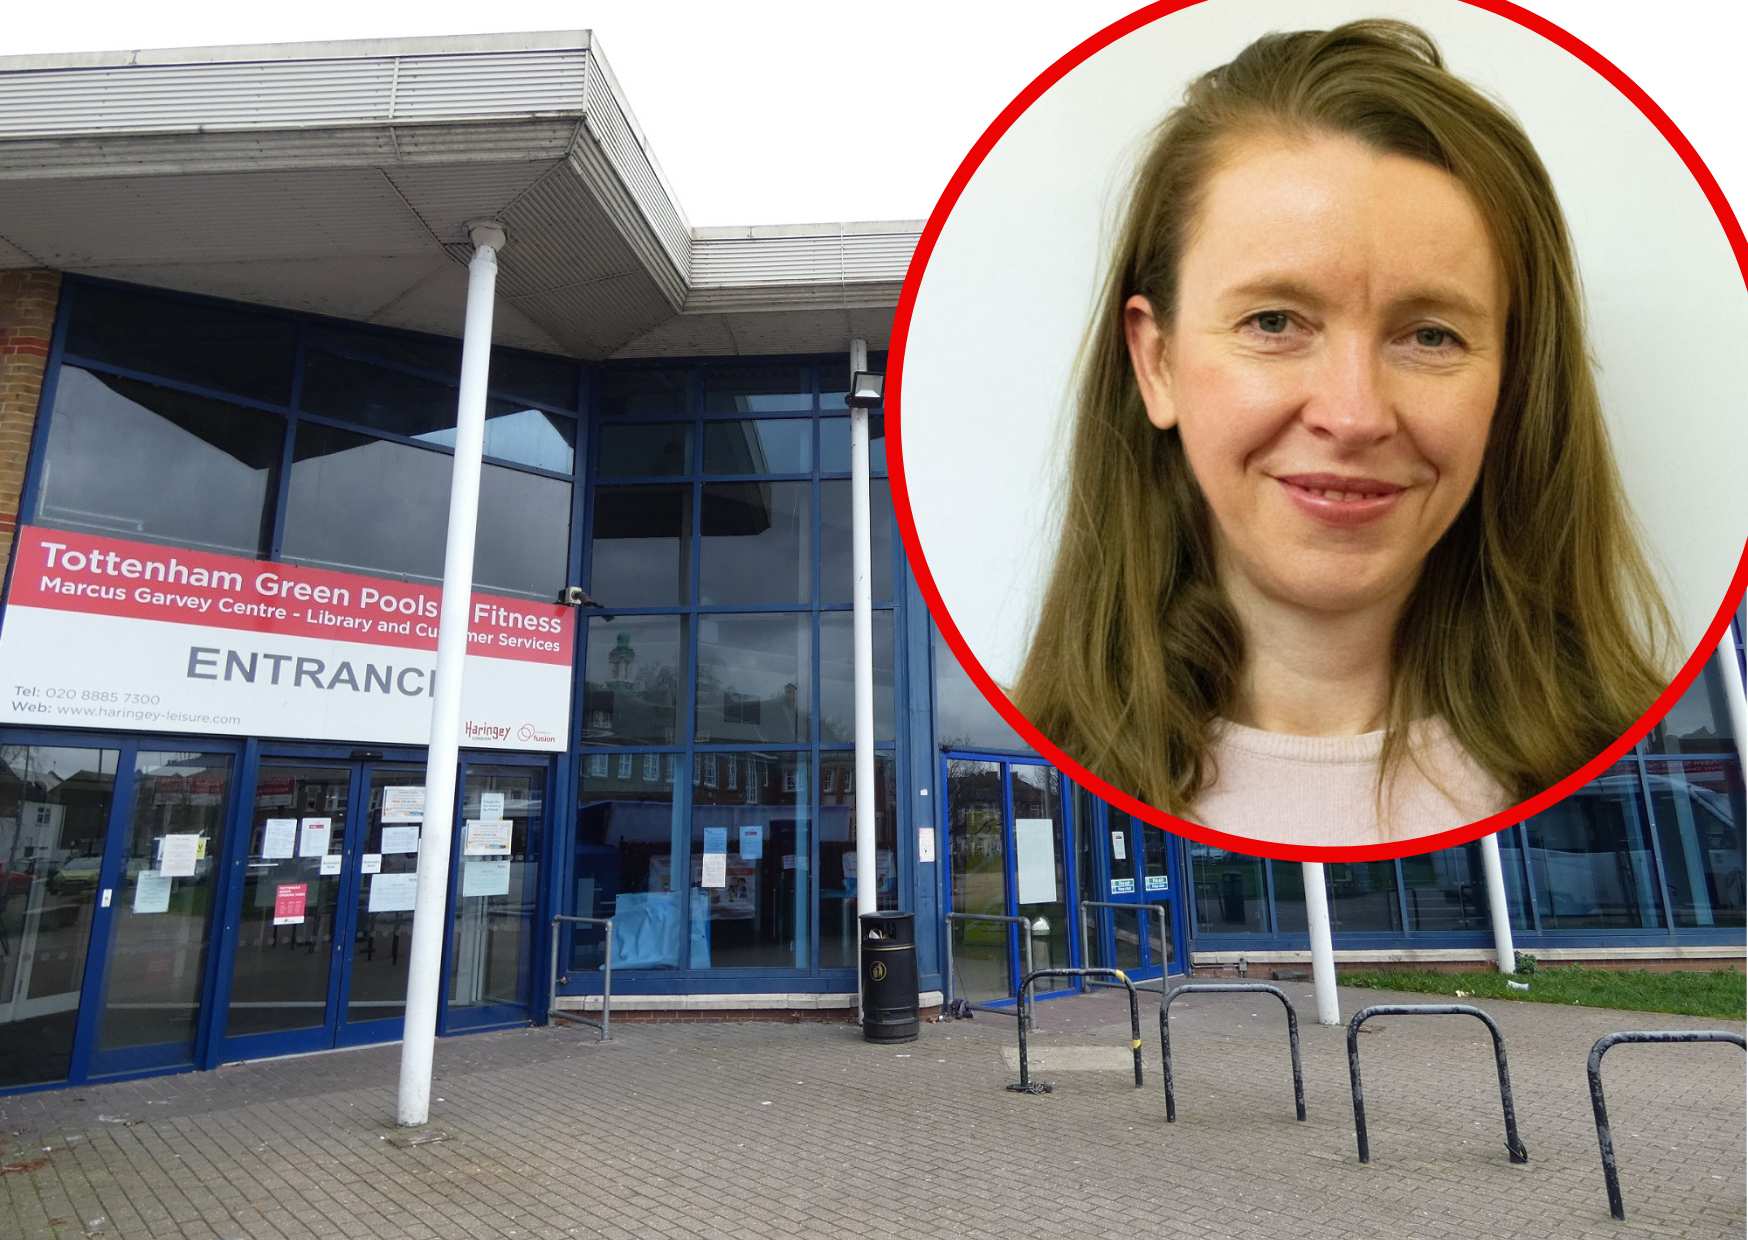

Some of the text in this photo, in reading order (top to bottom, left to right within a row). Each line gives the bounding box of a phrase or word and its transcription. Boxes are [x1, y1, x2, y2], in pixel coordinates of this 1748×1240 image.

[41, 541, 562, 634] Tottenham Green Pools Fitness
[40, 575, 126, 600] Marcus
[134, 587, 212, 612] Garvey
[219, 598, 287, 619] Centre
[307, 609, 372, 633] Library
[377, 620, 411, 635] and
[415, 623, 494, 645] Cumer
[498, 633, 561, 652] Services
[187, 646, 436, 698] ENTRANC
[12, 701, 241, 726] Web: www.haringey-leisure.com
[14, 685, 161, 706] Tel: 020 8885 7300
[465, 720, 512, 741] Haringey
